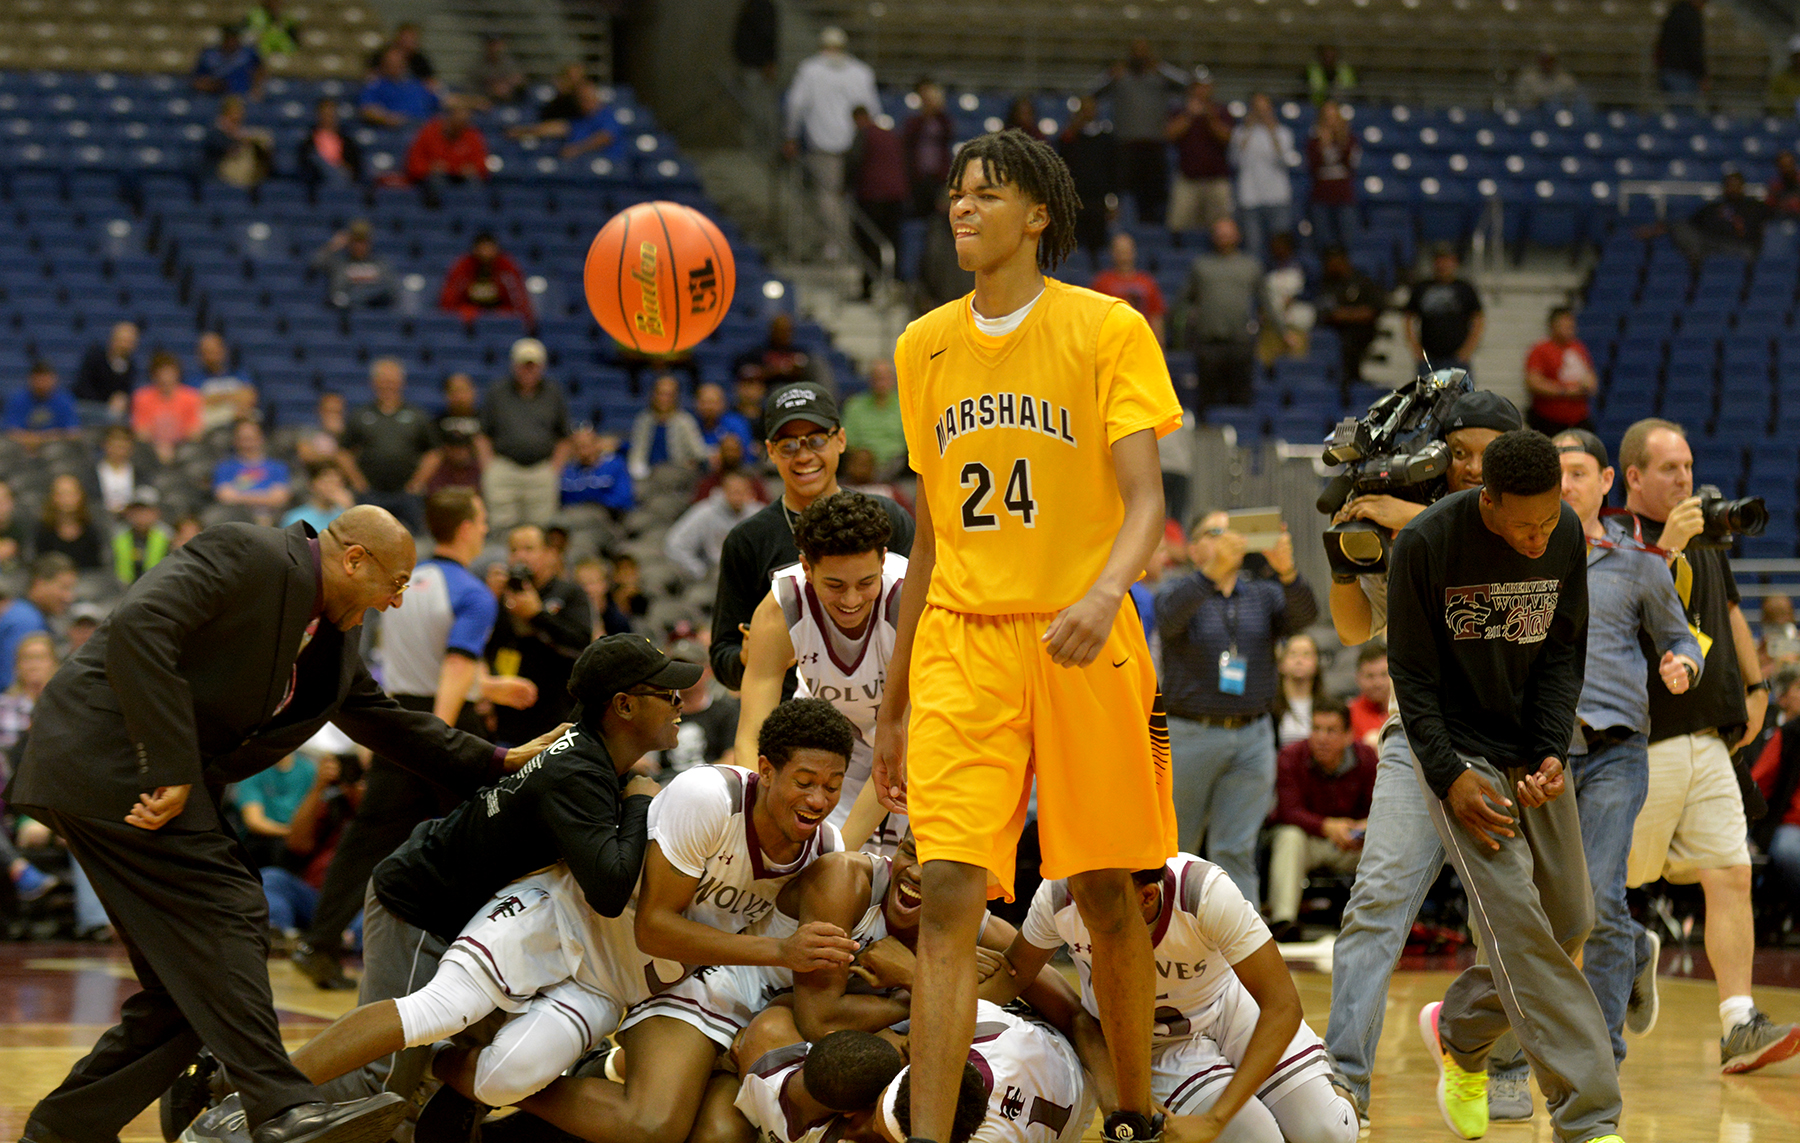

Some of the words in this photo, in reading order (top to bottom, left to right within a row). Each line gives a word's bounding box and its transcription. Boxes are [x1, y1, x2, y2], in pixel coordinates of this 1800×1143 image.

[934, 391, 1078, 459] MARSHALL
[960, 458, 1039, 532] 24
[695, 869, 773, 918] WOLVE
